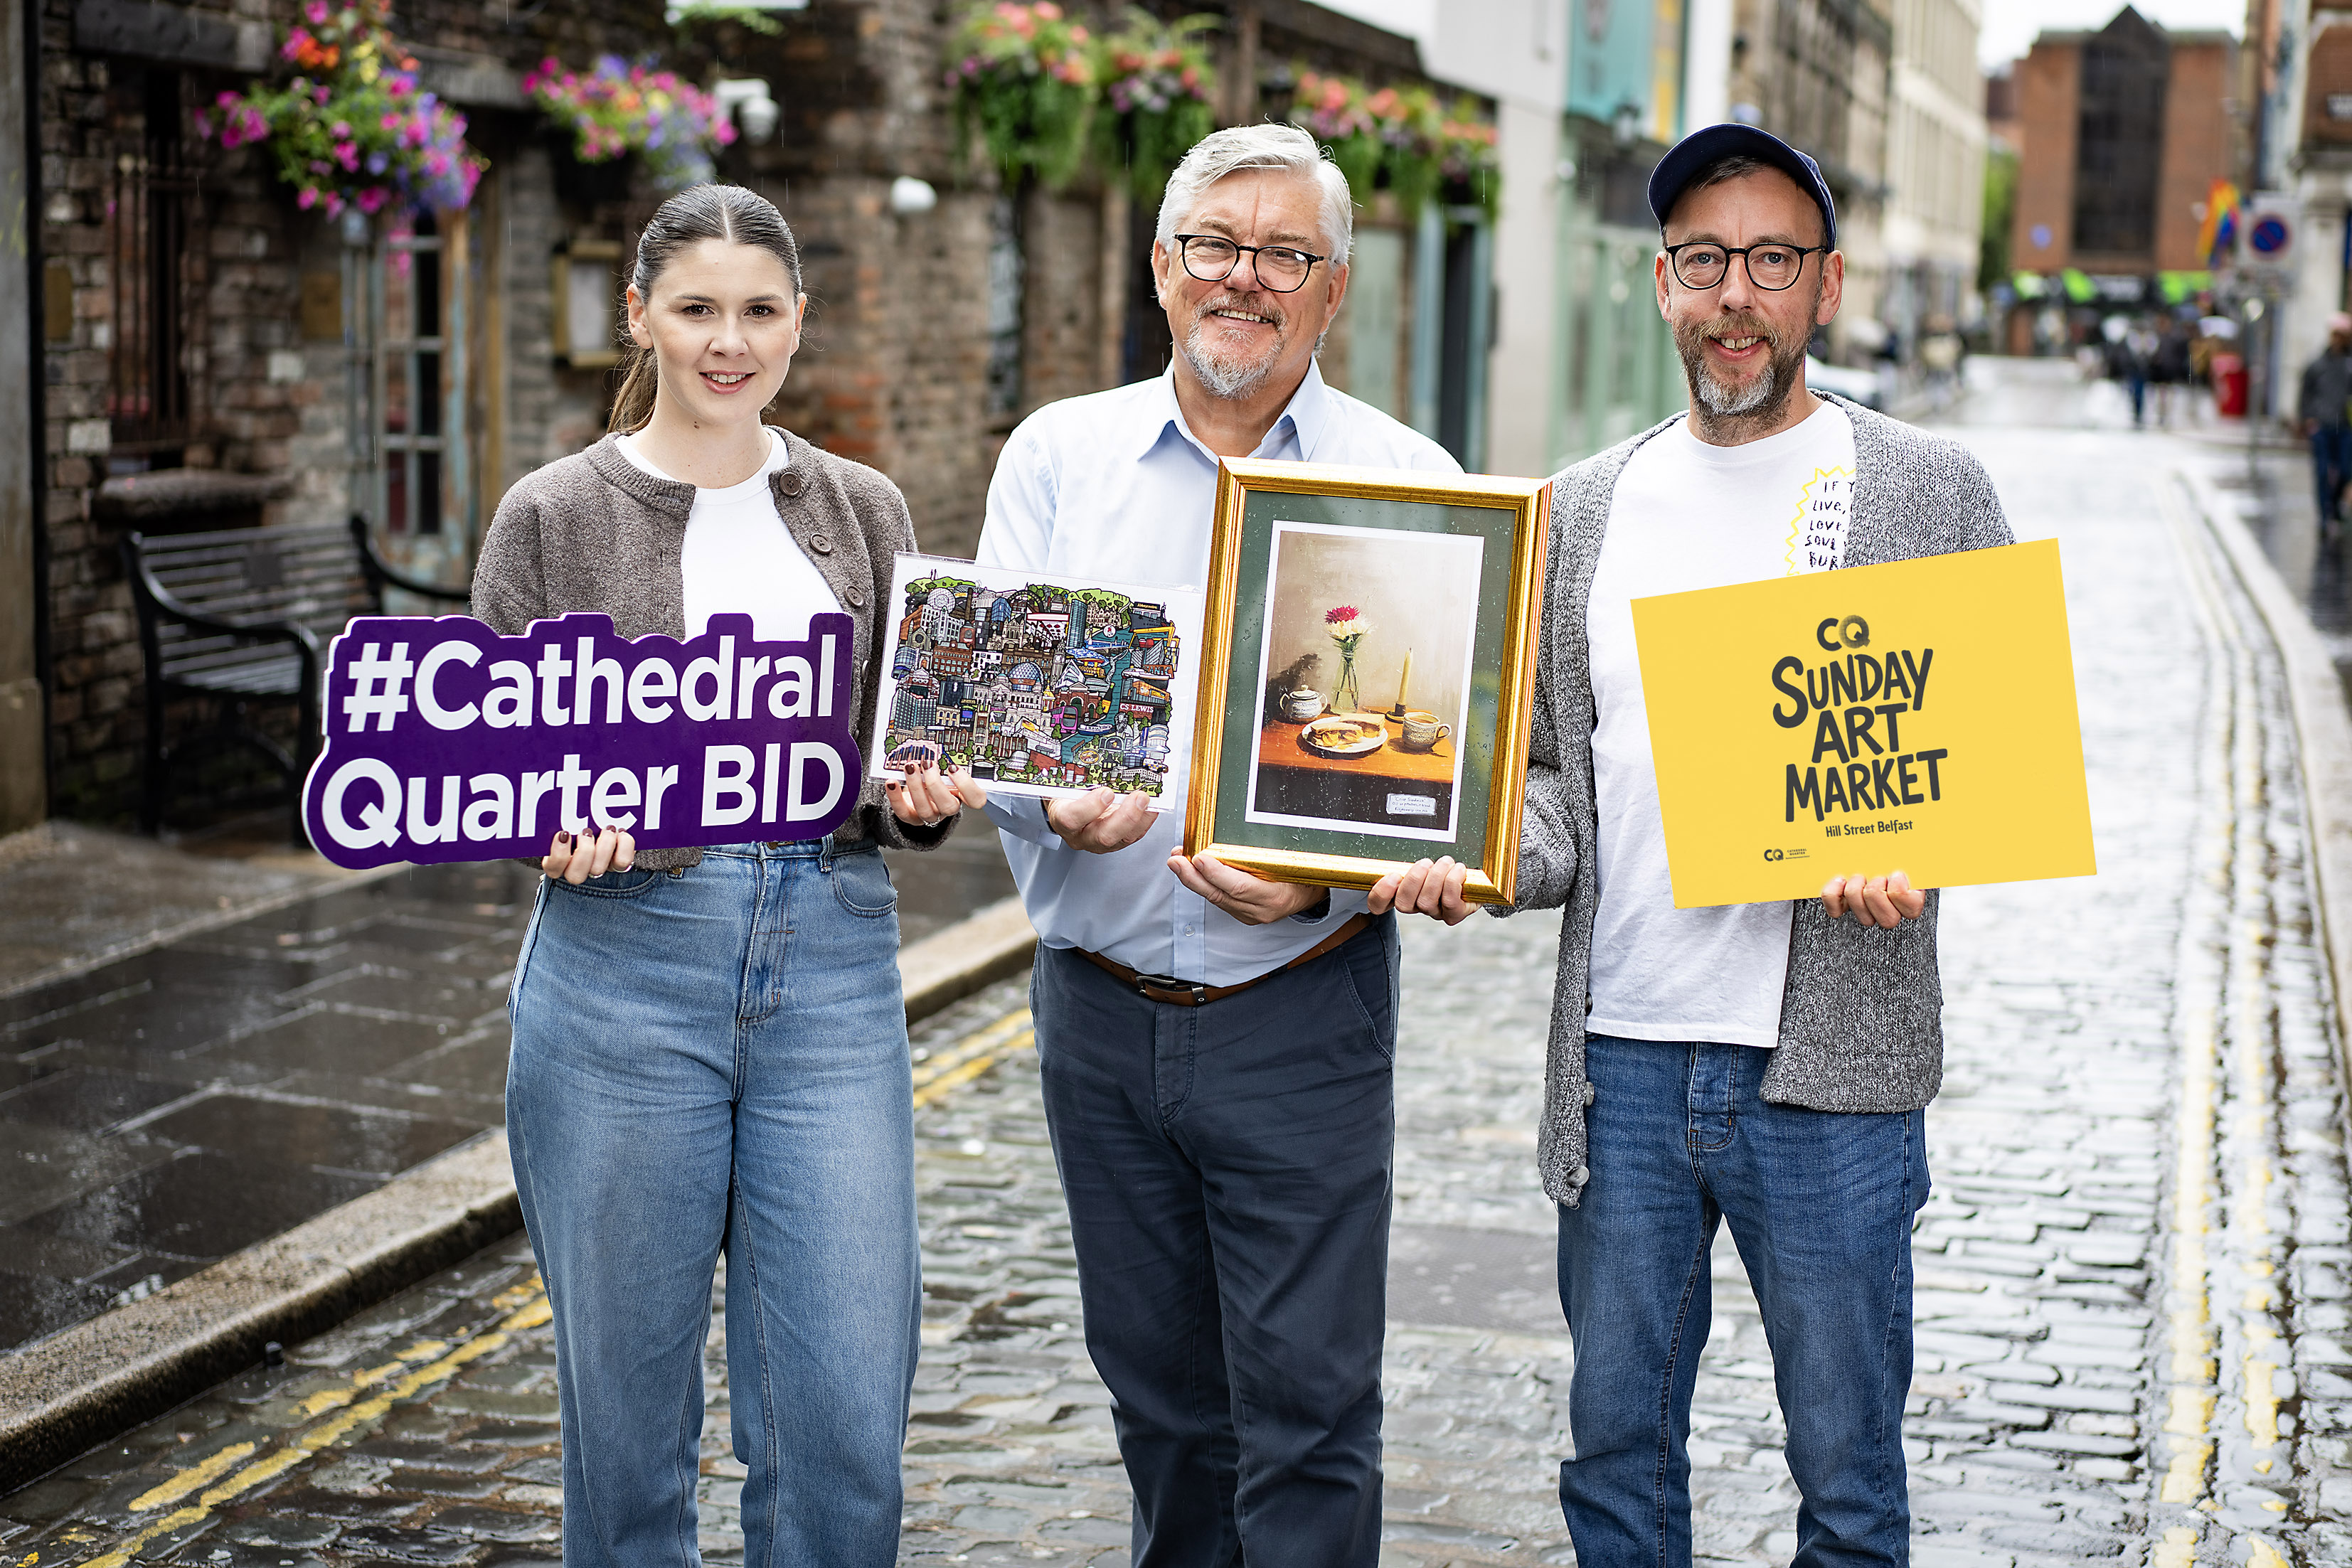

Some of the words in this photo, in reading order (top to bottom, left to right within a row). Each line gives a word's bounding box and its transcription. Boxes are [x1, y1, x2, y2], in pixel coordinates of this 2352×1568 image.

[1824, 481, 1839, 493] IF
[1816, 614, 1871, 651] CQ
[342, 634, 836, 733] #Cathedral
[1772, 648, 1933, 728] SUNDAY
[1131, 704, 1154, 713] LEWIS
[1811, 702, 1908, 764] ART
[321, 753, 679, 849] Quarter
[701, 741, 845, 827] BID
[1785, 748, 1948, 822] MARKET
[1826, 826, 1841, 838] Hill
[1844, 823, 1875, 836] Street
[1878, 819, 1913, 834] Belfast
[1764, 848, 1784, 862] CQ
